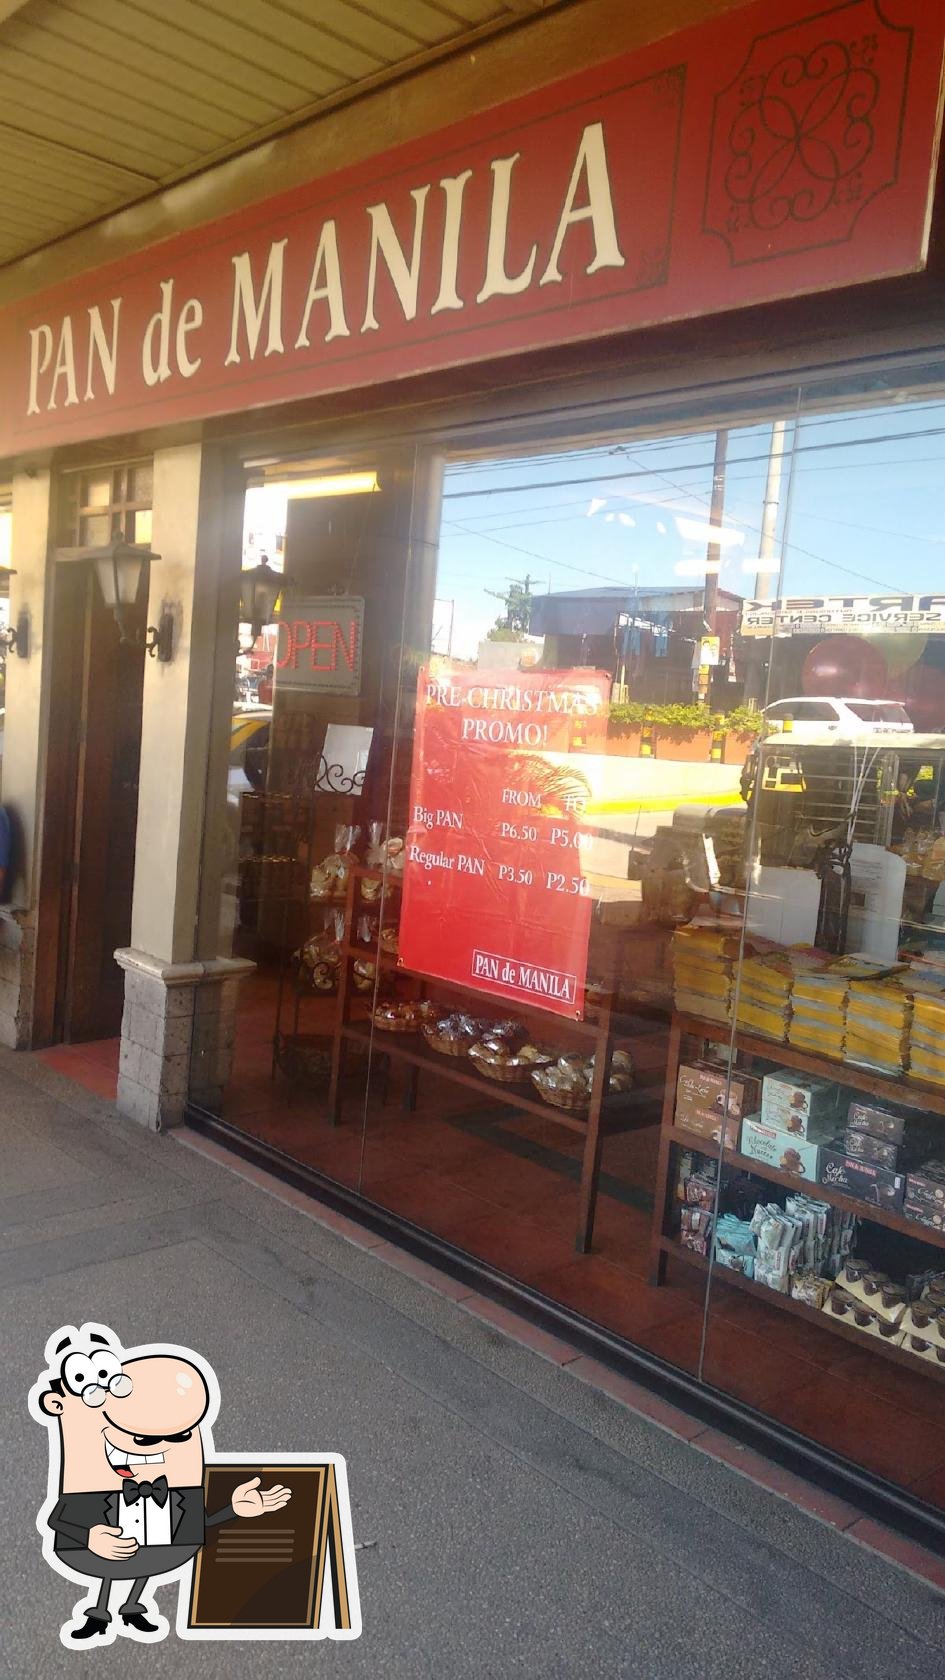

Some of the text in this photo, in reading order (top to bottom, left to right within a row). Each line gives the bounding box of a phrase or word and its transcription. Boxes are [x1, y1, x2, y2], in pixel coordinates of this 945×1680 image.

[26, 121, 626, 416] PAN de MANILA
[276, 619, 356, 672] OPEN
[425, 684, 598, 716] PRE-CHRISTMAS
[461, 717, 548, 746] PROMO!
[501, 787, 543, 808] FROM
[413, 806, 434, 830] Big
[436, 809, 464, 830] PAN
[501, 822, 538, 842] P6.50
[409, 845, 590, 897] Regular PAN P3.50 P2.50
[475, 954, 571, 1000] PAN de MANILA
